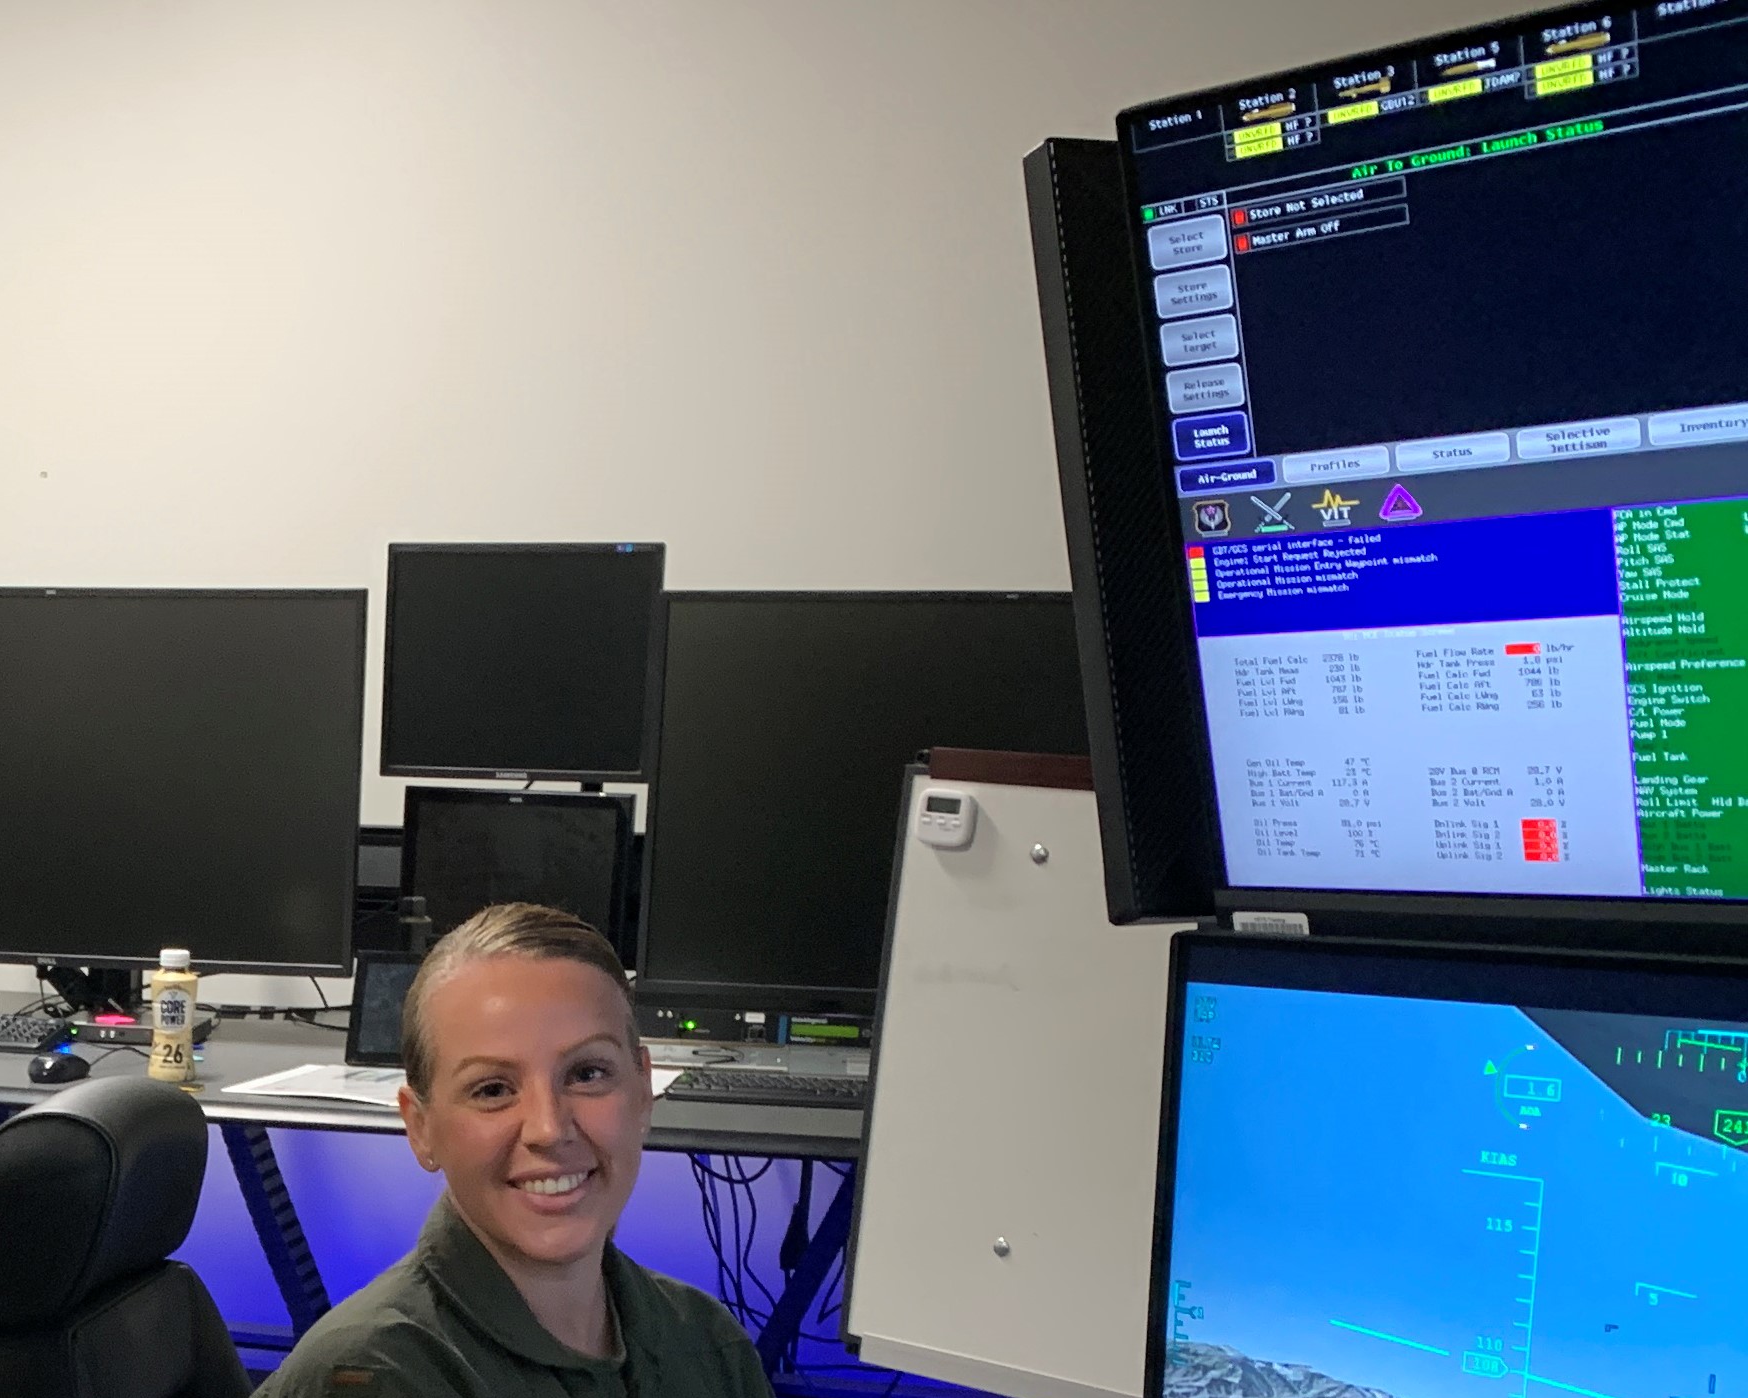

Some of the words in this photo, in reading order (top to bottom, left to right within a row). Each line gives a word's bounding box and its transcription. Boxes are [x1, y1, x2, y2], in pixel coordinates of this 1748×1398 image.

[1542, 21, 1597, 43] Station
[1602, 16, 1612, 29] 6
[1434, 46, 1486, 66] Station
[1334, 70, 1382, 89] Station
[1239, 92, 1284, 110] Station
[1288, 88, 1297, 99] 2
[1148, 113, 1193, 131] Station
[1352, 163, 1378, 180] Air
[1387, 160, 1403, 173] To
[1481, 131, 1538, 154] Launch
[1545, 119, 1605, 141] Status
[1250, 206, 1282, 220] Store
[1286, 202, 1306, 213] Not
[1311, 189, 1364, 208] Selected
[1169, 231, 1204, 244] Select
[1252, 232, 1289, 246] Master
[1295, 227, 1317, 238] Arm
[1320, 219, 1341, 234] Off
[1171, 292, 1218, 306] Settings
[1181, 330, 1216, 341] Select
[1183, 388, 1230, 401] Settings
[1193, 424, 1229, 437] Launch
[1545, 426, 1611, 443] Selective
[1193, 436, 1230, 449] Status
[1432, 445, 1473, 460] Status
[1198, 469, 1257, 484] Air-Ground
[1320, 506, 1352, 521] VIT
[1215, 565, 1270, 578] Operational
[1216, 577, 1271, 590] Operational
[160, 1000, 186, 1014] CORE
[160, 1014, 186, 1026] POWER
[162, 1043, 184, 1064] 26
[1481, 1150, 1518, 1167] KIAS
[1486, 1217, 1513, 1233] 115
